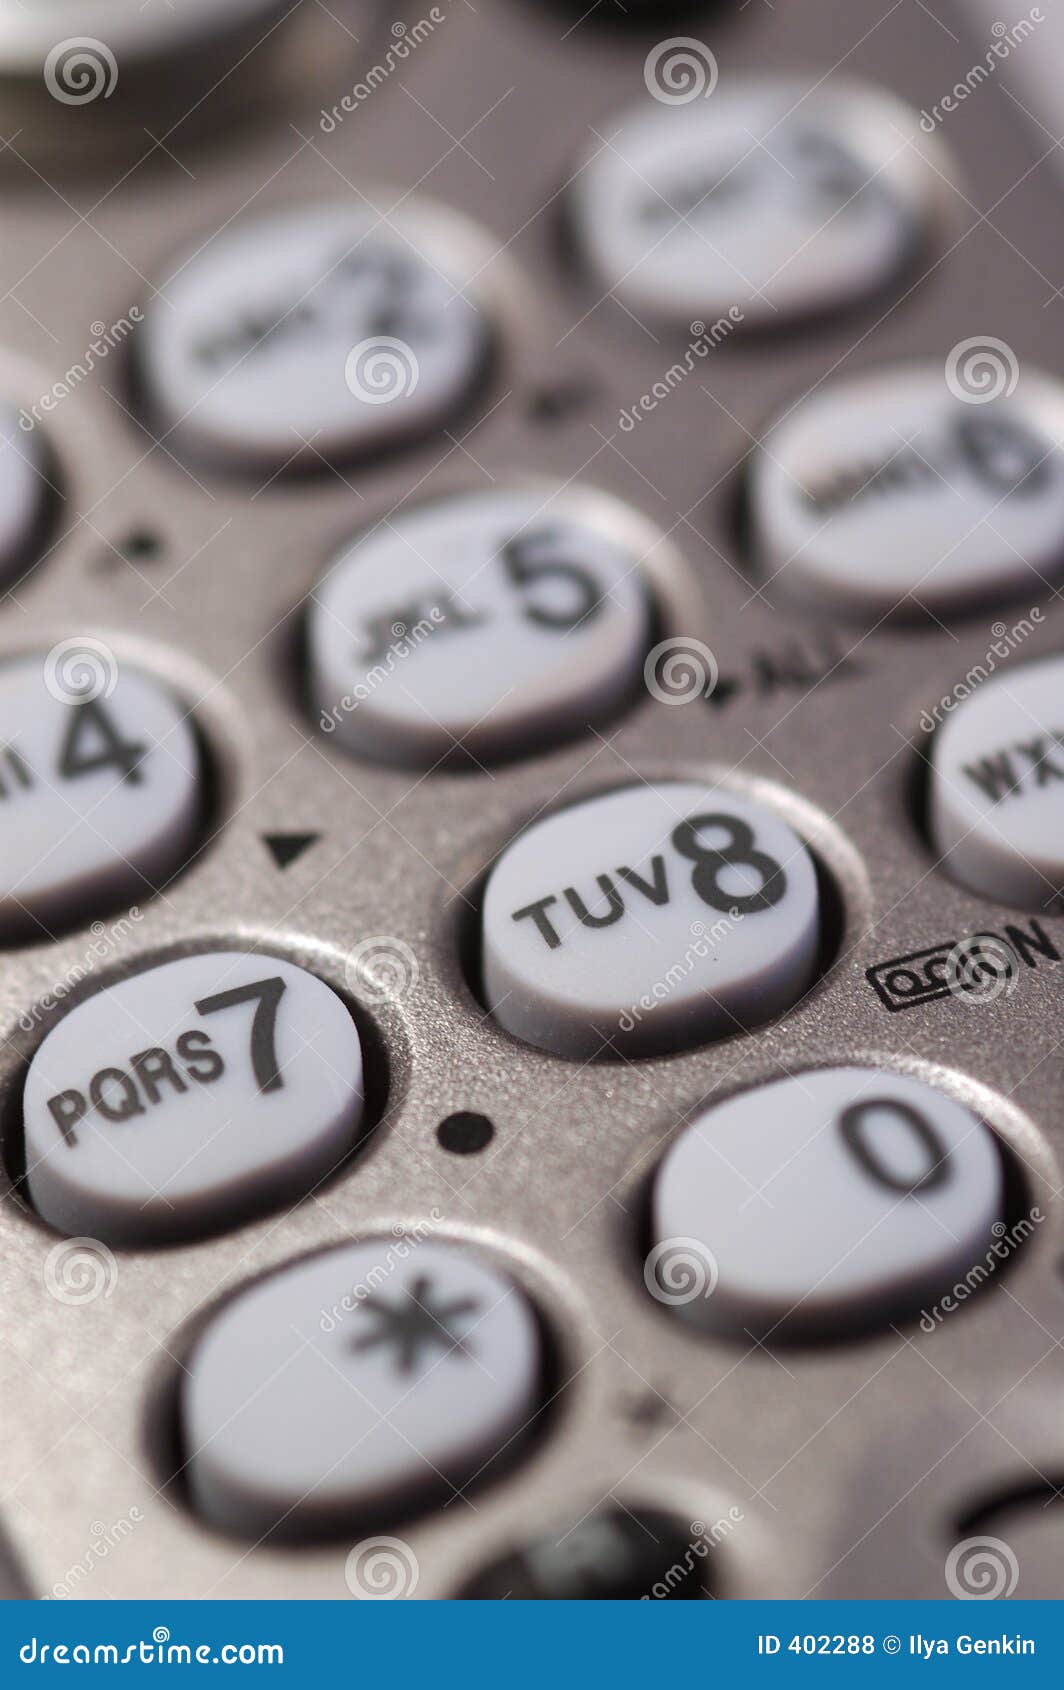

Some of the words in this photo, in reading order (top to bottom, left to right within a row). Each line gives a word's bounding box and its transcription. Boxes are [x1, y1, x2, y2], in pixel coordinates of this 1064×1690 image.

[945, 402, 1060, 506] 6
[498, 525, 606, 636] 5
[58, 690, 147, 788] 4
[961, 730, 1064, 804] WX
[512, 855, 669, 950] TUV
[672, 813, 787, 915] 8
[46, 1030, 225, 1148] PQRS
[195, 976, 286, 1094] 7
